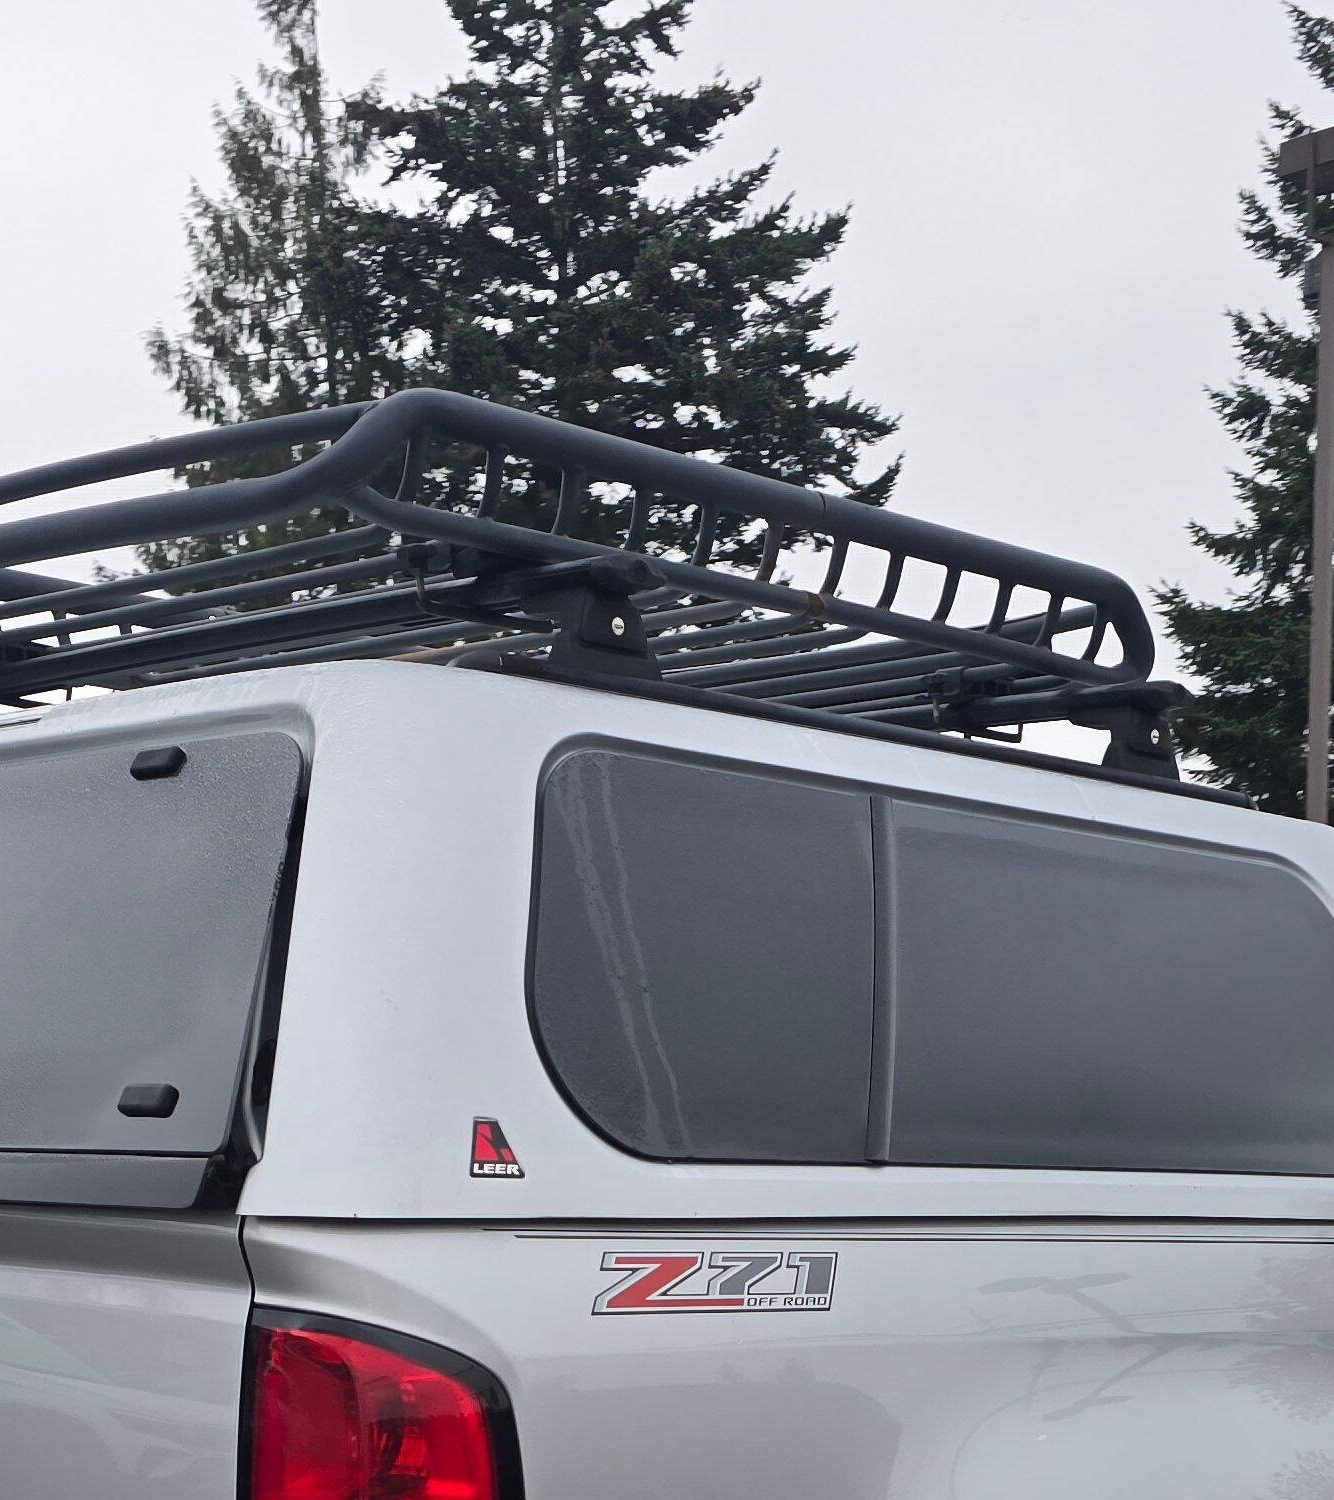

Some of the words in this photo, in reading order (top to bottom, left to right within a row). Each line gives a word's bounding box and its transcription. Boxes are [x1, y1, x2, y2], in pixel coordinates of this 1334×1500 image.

[473, 1162, 520, 1175] LEER
[591, 1250, 839, 1316] Z71
[746, 1297, 779, 1307] OFF
[782, 1296, 828, 1307] ROAD
